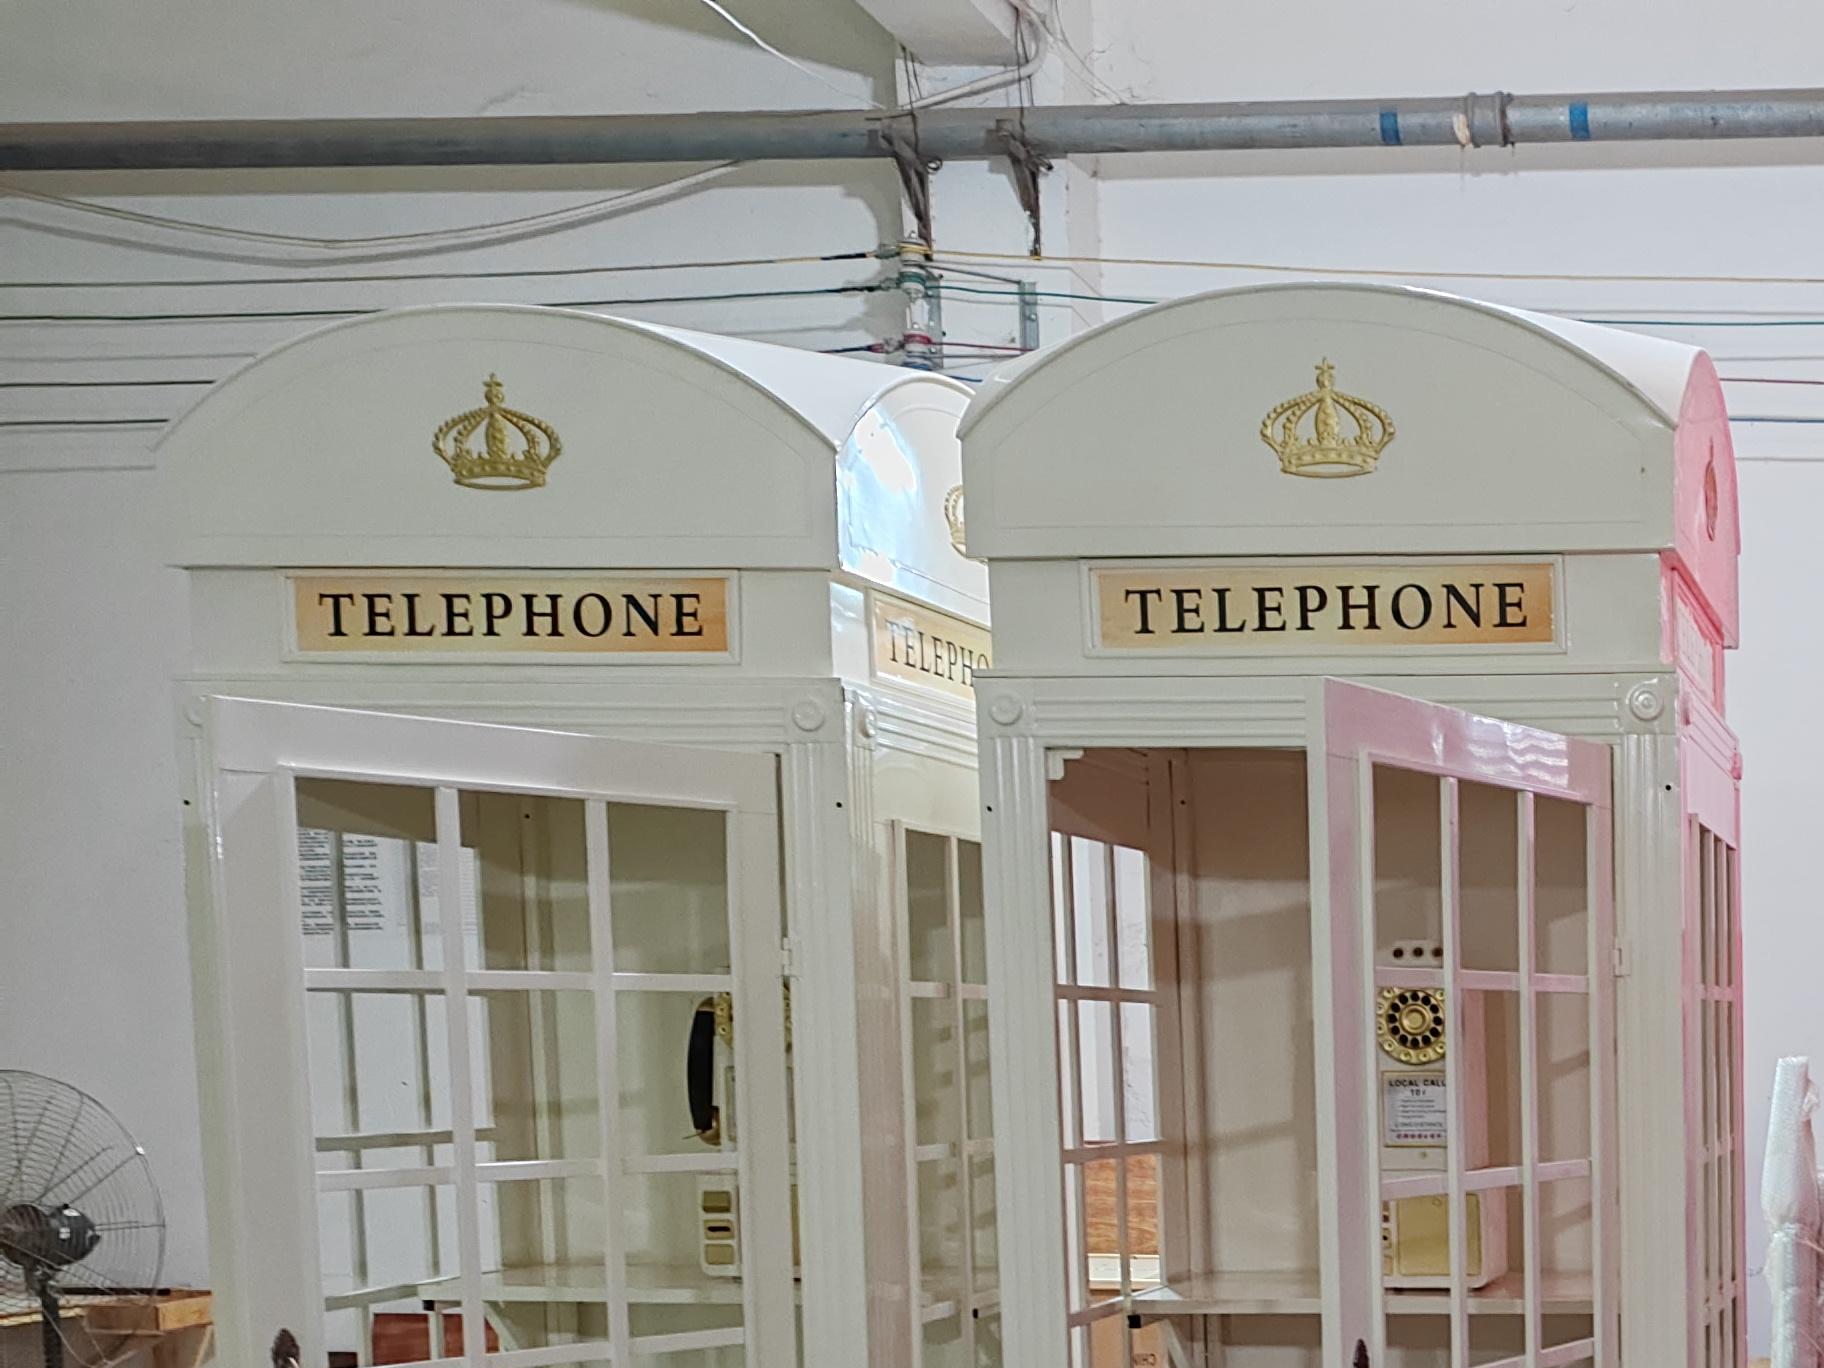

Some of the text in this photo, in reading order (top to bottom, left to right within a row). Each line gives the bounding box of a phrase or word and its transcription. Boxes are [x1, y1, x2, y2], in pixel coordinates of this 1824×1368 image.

[318, 592, 705, 638] TELEPHONE
[1124, 582, 1529, 635] TELEPHONE
[1388, 1079, 1420, 1088] LOCAL
